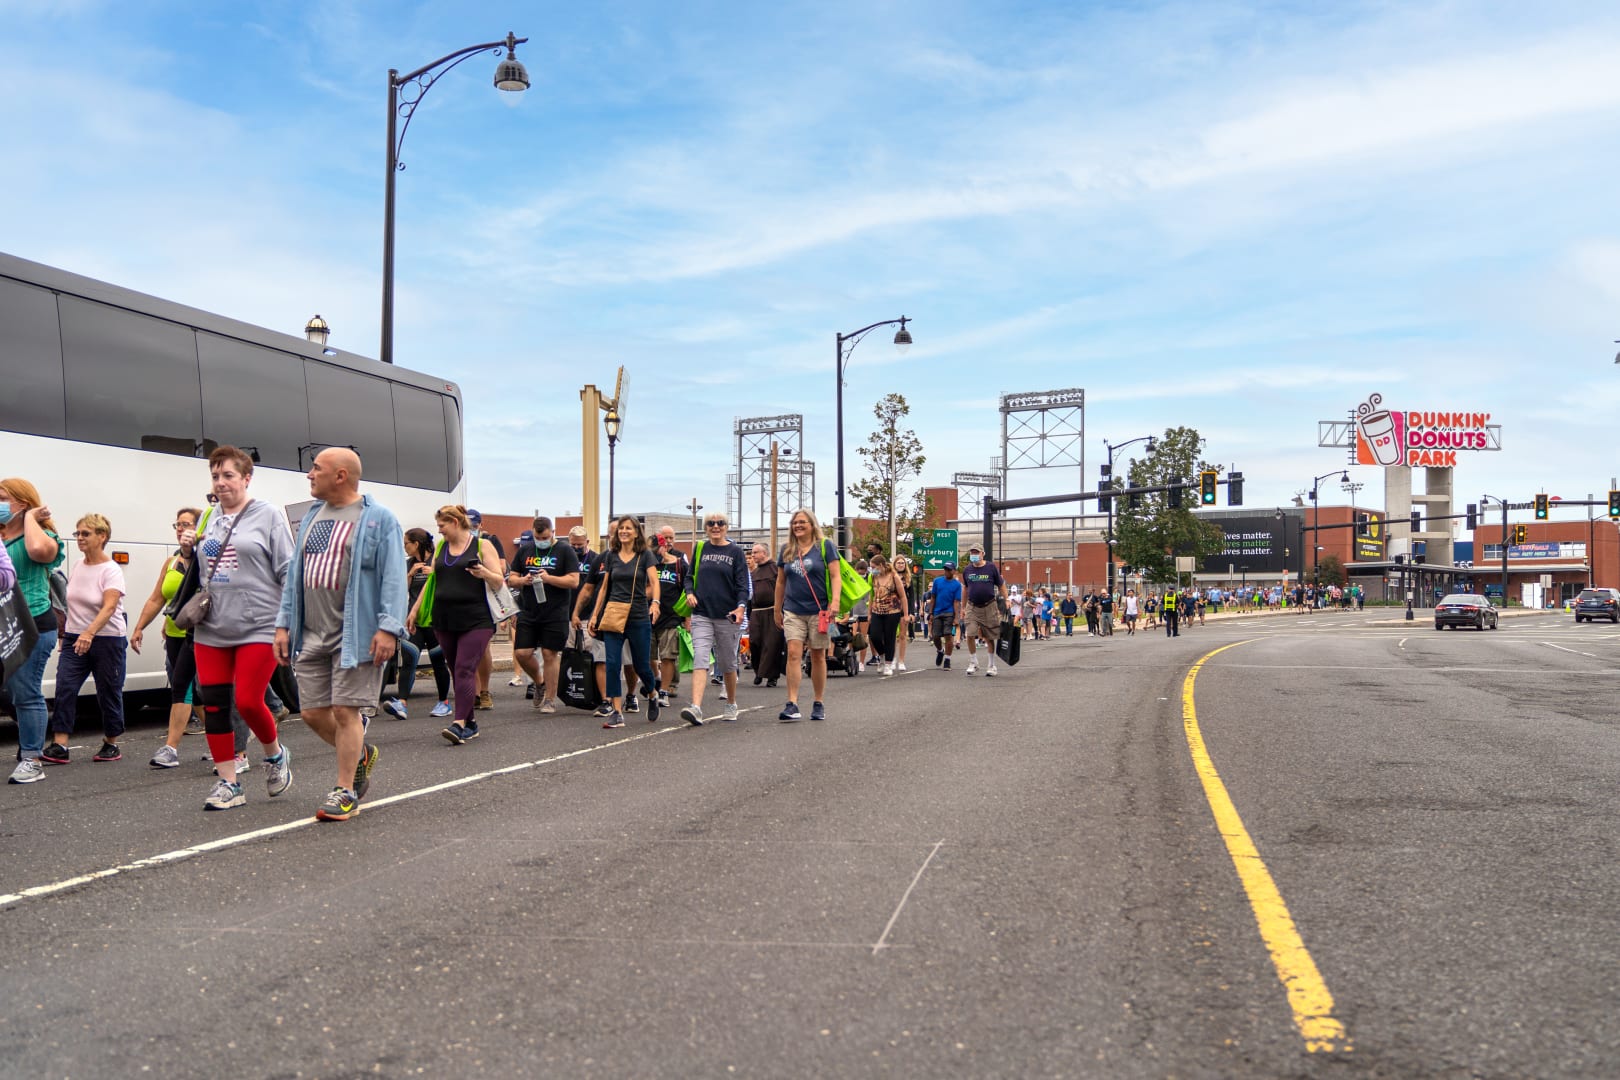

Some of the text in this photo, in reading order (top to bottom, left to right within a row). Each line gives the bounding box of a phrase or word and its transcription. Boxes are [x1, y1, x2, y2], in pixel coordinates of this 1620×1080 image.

[1408, 411, 1491, 428] DUNKIN'
[1375, 436, 1391, 448] DD
[1408, 431, 1486, 448] DONUTS
[1408, 450, 1457, 466] PARK
[1224, 532, 1273, 540] ives matter.
[917, 549, 954, 558] Waterbury
[1242, 547, 1273, 555] matter.
